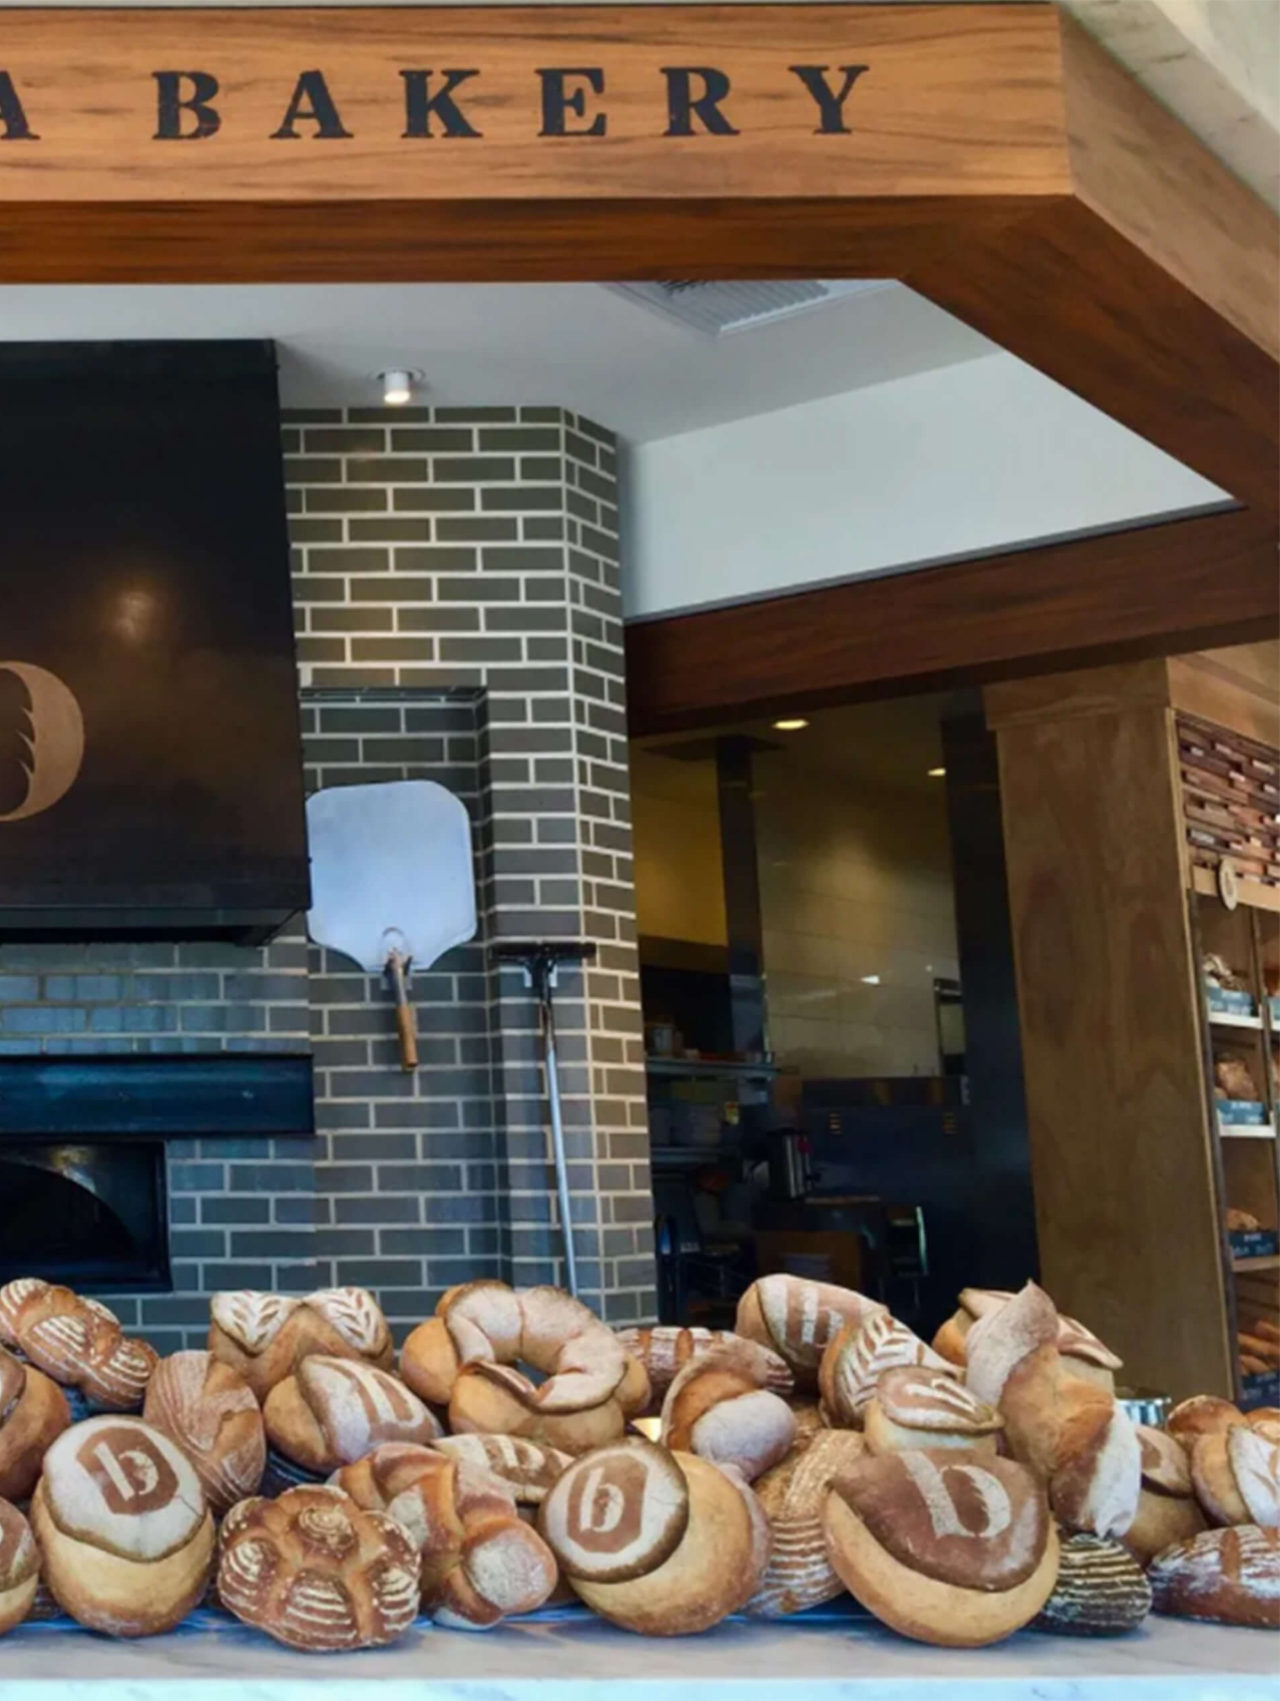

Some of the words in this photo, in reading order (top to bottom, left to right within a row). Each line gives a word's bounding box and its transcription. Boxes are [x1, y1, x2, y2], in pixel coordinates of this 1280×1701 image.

[153, 65, 868, 139] BAKERY
[93, 1441, 159, 1501] b
[579, 1466, 625, 1533] b
[900, 1452, 1012, 1538] b
